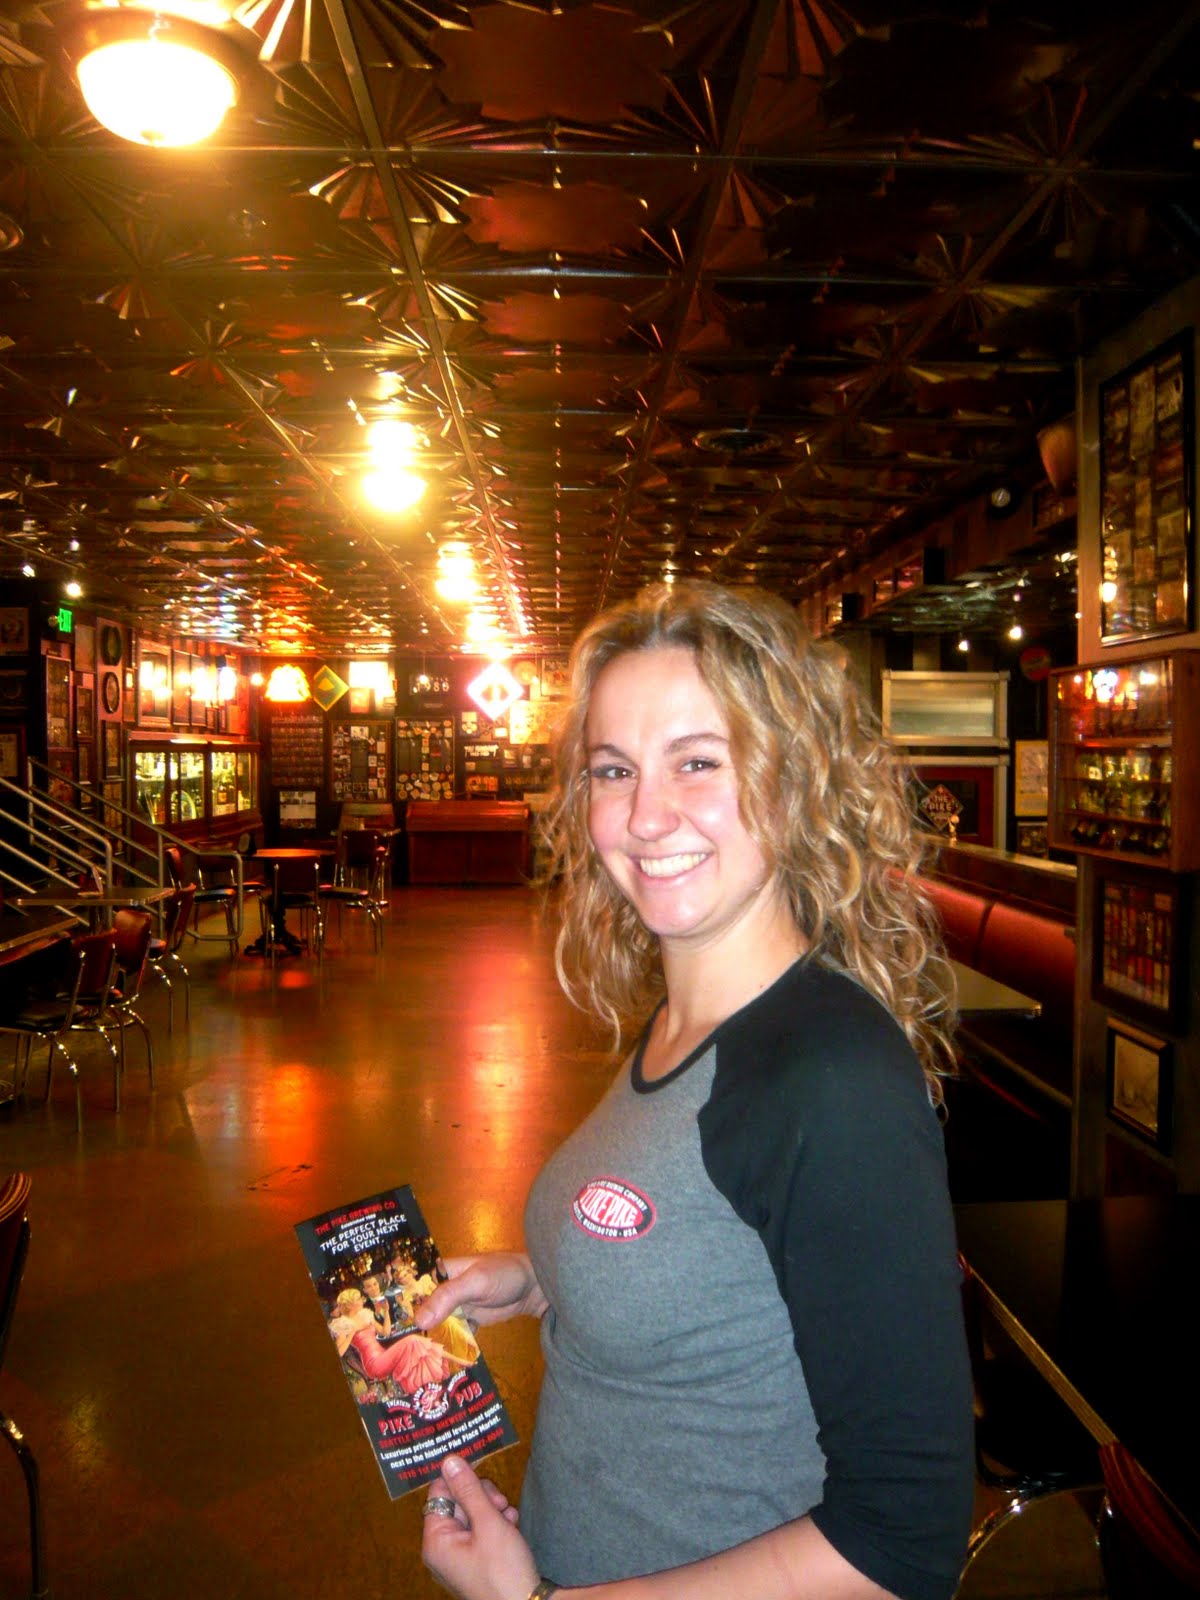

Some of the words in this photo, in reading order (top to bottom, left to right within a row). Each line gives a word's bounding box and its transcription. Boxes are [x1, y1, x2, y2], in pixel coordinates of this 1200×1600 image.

[600, 1194, 639, 1229] PIKE
[623, 1189, 648, 1212] COMPANY
[315, 1222, 331, 1236] THE
[331, 1214, 348, 1228] PIKE
[348, 1203, 383, 1220] BREWING
[320, 1236, 337, 1251] THE
[338, 1221, 376, 1241] PERFECT
[378, 1214, 407, 1228] PLACE
[623, 1227, 637, 1237] USA
[332, 1243, 350, 1255] FOR
[350, 1230, 375, 1245] YOUR
[376, 1223, 400, 1236] NEXT
[354, 1236, 385, 1252] EVENT.
[455, 1381, 483, 1407] PUB
[378, 1413, 415, 1436] PIKE
[379, 1434, 411, 1449] SEATTLE
[411, 1425, 436, 1440] MICRO
[435, 1409, 467, 1430] BREWERY
[467, 1391, 495, 1414] MUSEUM
[380, 1446, 412, 1460] Luxurious
[412, 1438, 435, 1454] private
[435, 1431, 453, 1444] multi
[451, 1424, 468, 1436] level
[468, 1413, 484, 1428] event
[390, 1460, 405, 1469] next
[405, 1458, 413, 1467] to
[413, 1452, 424, 1463] the
[424, 1446, 448, 1460] historic
[448, 1438, 462, 1450] Pike
[461, 1430, 480, 1444] Place
[479, 1415, 502, 1433] Market.
